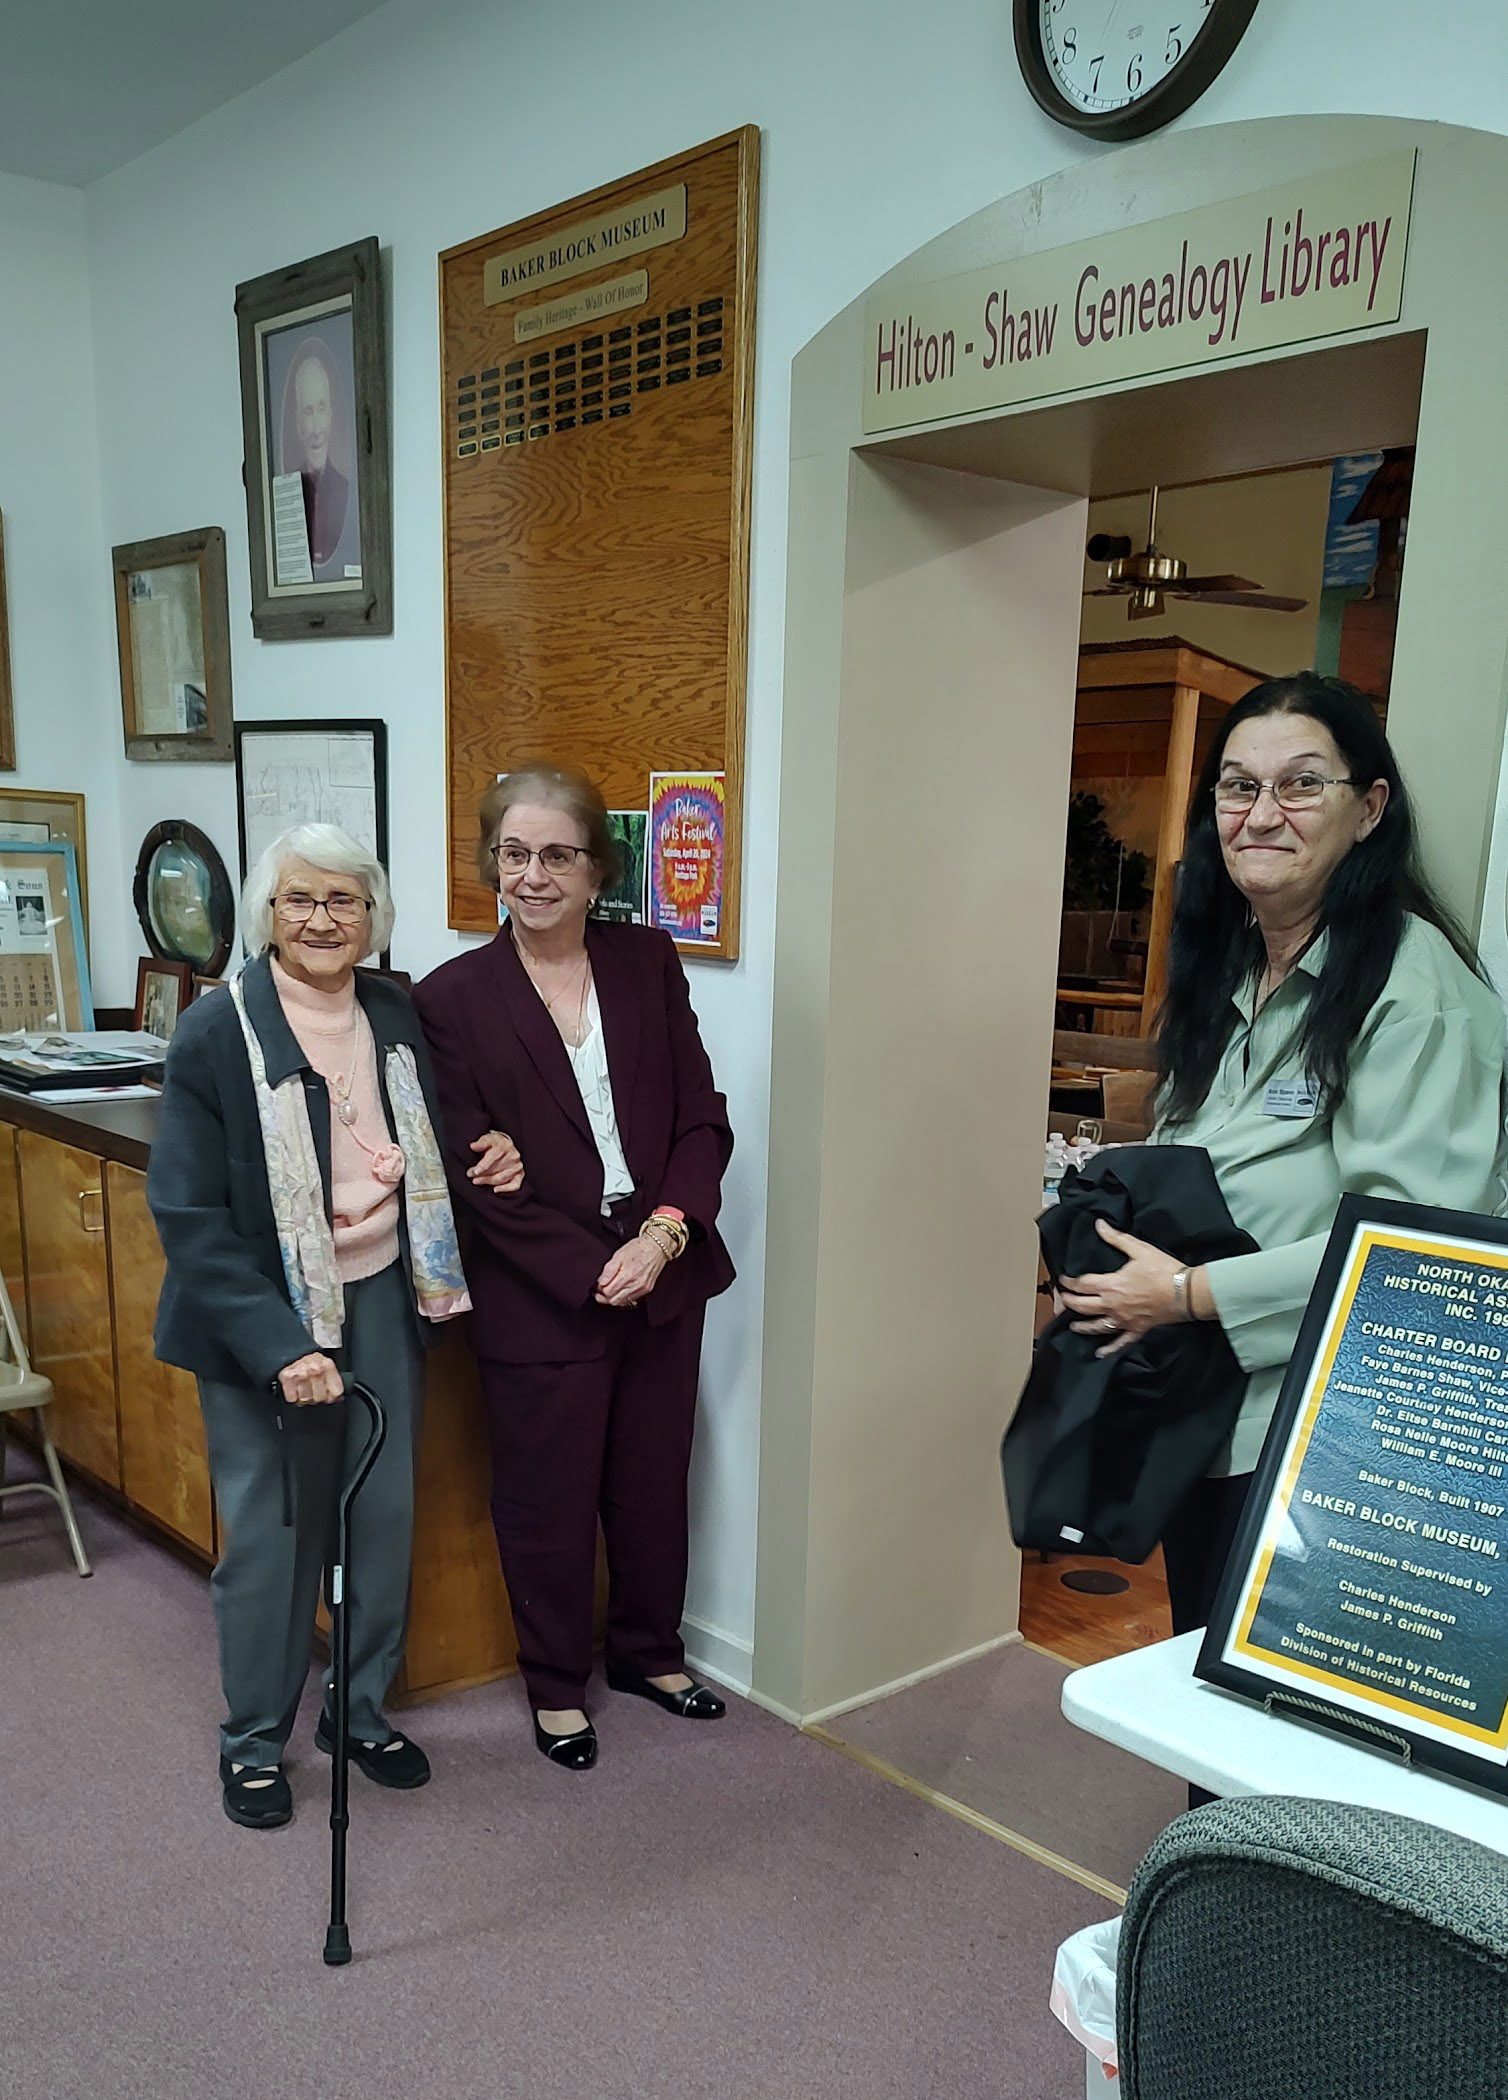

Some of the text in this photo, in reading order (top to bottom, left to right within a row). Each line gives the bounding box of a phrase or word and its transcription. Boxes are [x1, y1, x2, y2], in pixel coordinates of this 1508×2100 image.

[1061, 27, 1077, 65] 8
[1165, 24, 1182, 64] 5
[1088, 54, 1105, 93] 7
[1127, 53, 1143, 92] 6
[501, 208, 666, 287] BAKER BLOCK MUSEUM
[518, 315, 544, 334] Family
[545, 304, 578, 326] Heritage
[584, 292, 603, 311] Wall
[618, 282, 643, 301] Honor
[877, 315, 955, 395] Hilton
[983, 288, 1058, 369] Shaw
[1073, 240, 1253, 346] Genealogy
[1260, 208, 1392, 311] Library
[675, 797, 700, 817] Baker
[661, 821, 717, 841] Arts Festival
[1383, 1274, 1508, 1308] HISTORICAL AS
[1417, 1263, 1474, 1284] NORTH
[1444, 1303, 1477, 1321] INC.
[1361, 1321, 1501, 1361] CHARTER BOARD
[1361, 1355, 1389, 1371] Faye
[1392, 1361, 1434, 1380] Barnes
[1437, 1373, 1474, 1390] Shaw,
[1378, 1344, 1423, 1362] Charles
[1426, 1353, 1496, 1380] Henderson,
[1333, 1380, 1383, 1400] Jeanette
[1386, 1391, 1442, 1415] Courtney
[1375, 1374, 1413, 1391] James
[1416, 1383, 1427, 1394] P.
[1431, 1387, 1479, 1408] Griffith,
[1370, 1419, 1401, 1435] Rosa
[1404, 1428, 1437, 1444] Nelle
[1439, 1435, 1479, 1455] Moore
[1376, 1404, 1393, 1418] Dr.
[1431, 1418, 1482, 1439] Barnhill
[1381, 1437, 1503, 1478] William E. Moore III
[1358, 1469, 1505, 1518] Baker Block, Built 1907
[1301, 1489, 1501, 1560] BAKER BLOCK MUSEUM,
[1327, 1537, 1493, 1597] Restoration Supervised by
[1338, 1579, 1457, 1625] Charles Henderson
[1340, 1600, 1444, 1641] James P. Griffith
[1280, 1636, 1477, 1711] Division of Historical Resources
[1295, 1622, 1471, 1690] Sponsored in part by Florida
